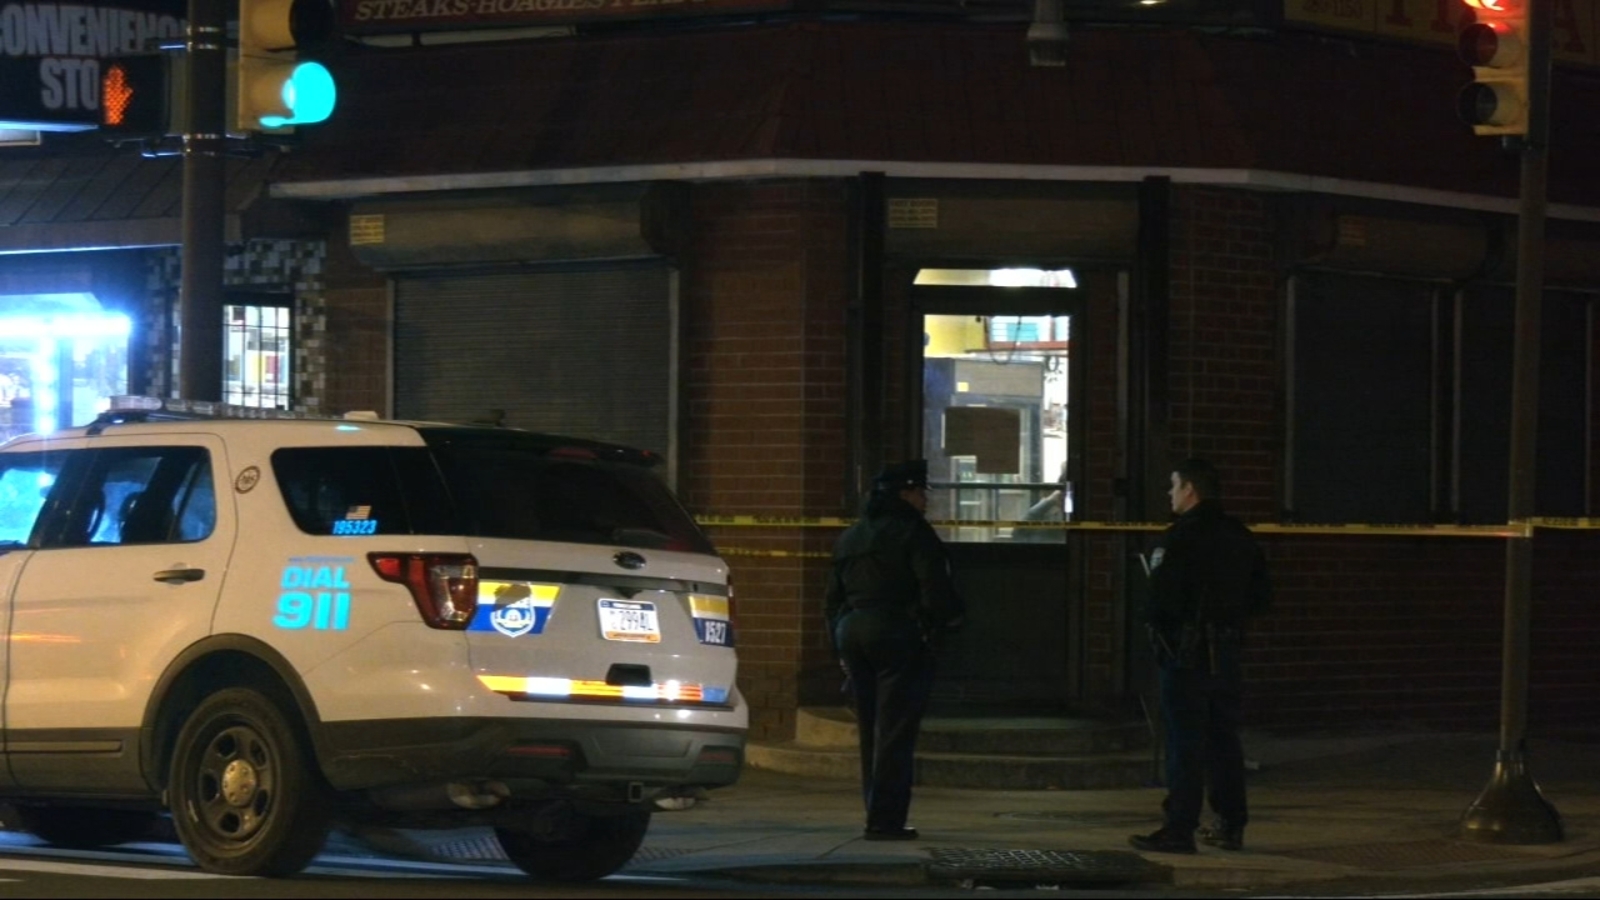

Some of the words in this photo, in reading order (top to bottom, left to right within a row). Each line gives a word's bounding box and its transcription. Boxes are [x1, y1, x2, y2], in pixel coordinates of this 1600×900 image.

[0, 4, 187, 57] ONVENIENC
[40, 57, 100, 111] STO
[332, 519, 378, 535] 195323
[280, 566, 351, 589] DIAL
[272, 591, 352, 630] 911
[705, 620, 726, 645] 1527
